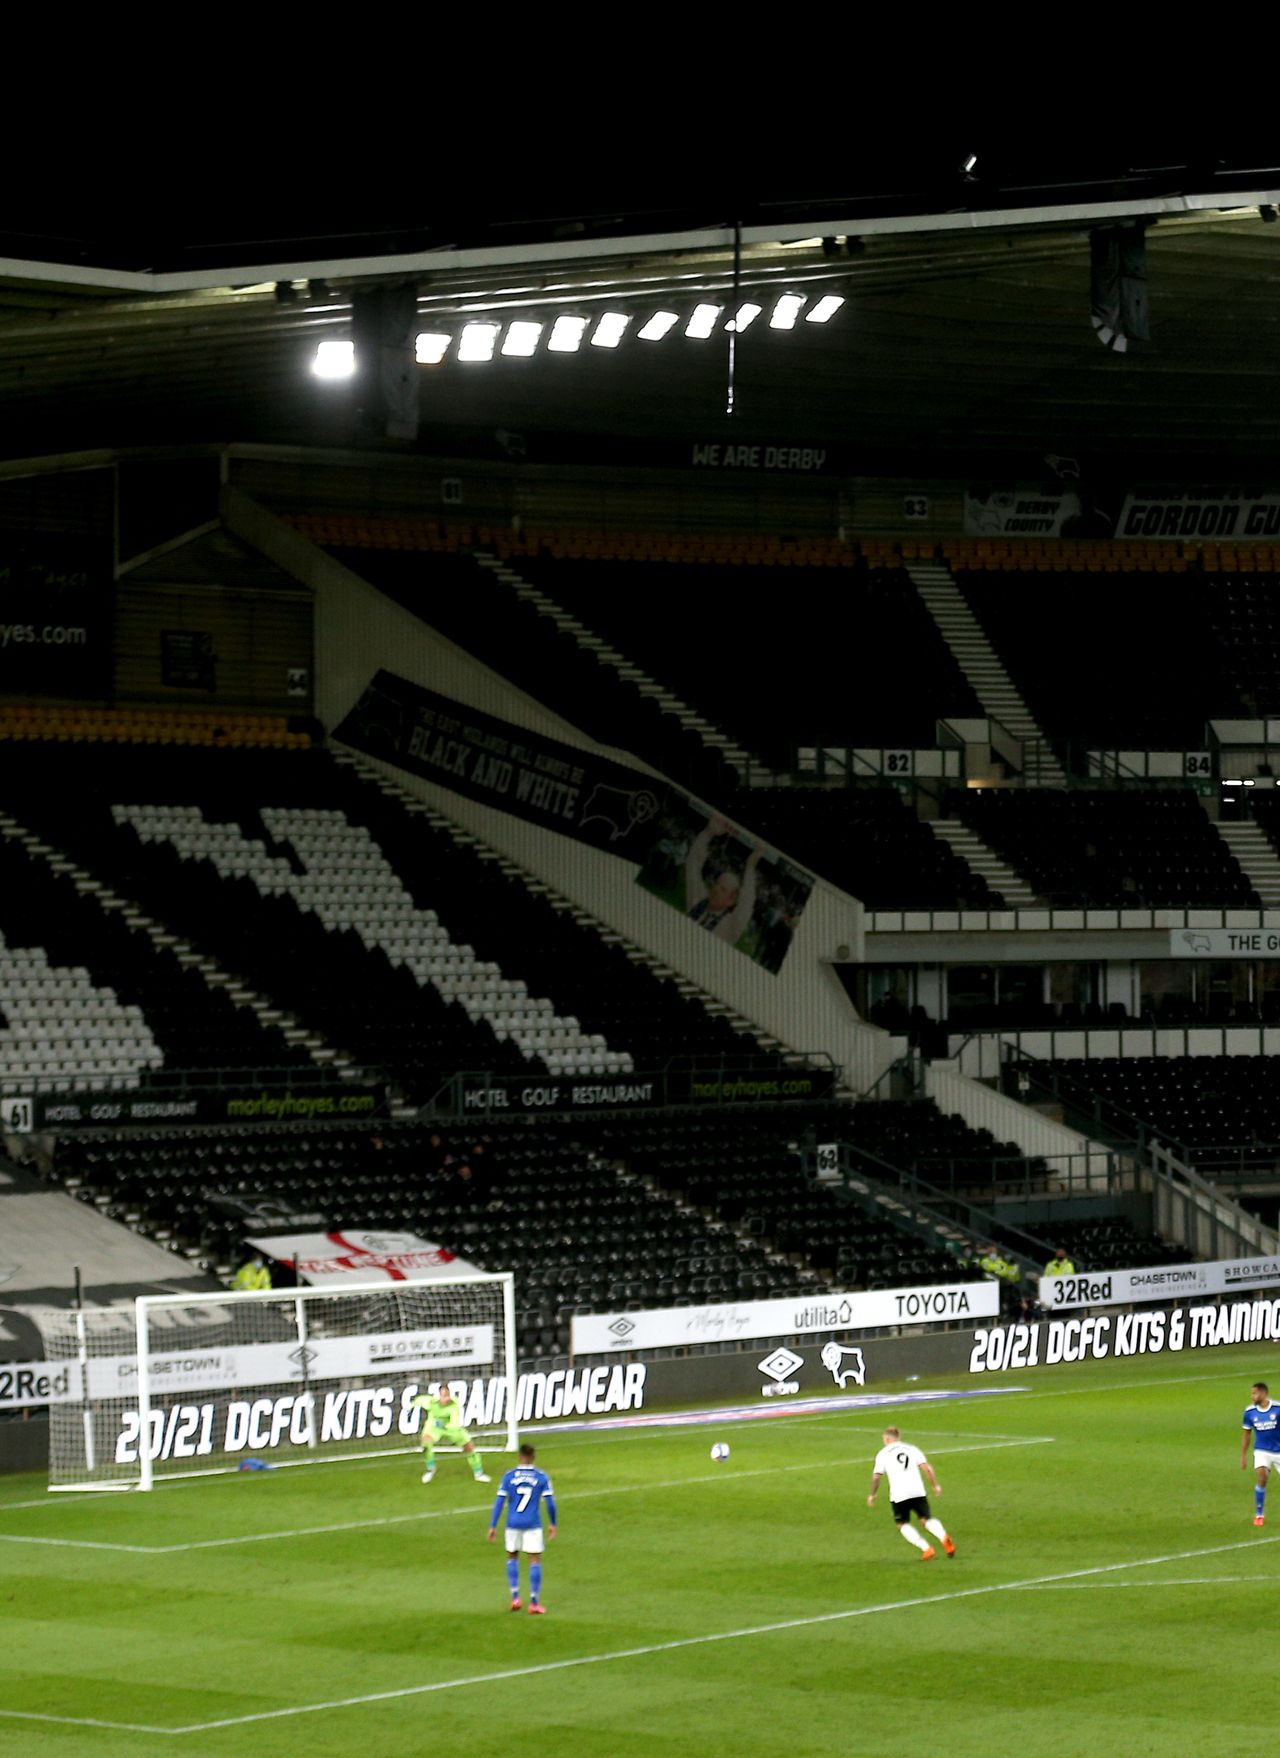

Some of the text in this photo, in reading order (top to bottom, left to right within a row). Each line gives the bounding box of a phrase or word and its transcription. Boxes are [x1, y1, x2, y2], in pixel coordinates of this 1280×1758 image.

[692, 443, 827, 470] WE ARE DERBY
[906, 499, 928, 517] 83
[1124, 504, 1240, 535] GORDON
[1005, 518, 1055, 532] COUNTY
[407, 725, 580, 820] BLACK AND WHITE
[887, 754, 909, 772] 82
[1187, 756, 1210, 774] 84
[1228, 935, 1262, 952] THE
[464, 1083, 655, 1109] HOTEL GOLF RESTAURANT
[10, 1103, 28, 1126] 61
[45, 1101, 198, 1121] HOTEL GOLF RESTAURANT
[1053, 1276, 1113, 1305] 32Red
[1130, 1271, 1197, 1287] CHASETOWN
[895, 1291, 970, 1318] TOYOTA
[794, 1306, 838, 1329] utilita
[368, 1336, 474, 1354] SHOWCASE
[969, 1323, 1041, 1373] 20/21
[1045, 1315, 1111, 1365] DCFC
[1114, 1309, 1167, 1357] KITS
[1168, 1308, 1184, 1351] &
[224, 1395, 315, 1453] DCFC
[321, 1386, 394, 1443] KITS
[896, 1452, 909, 1472] 9
[516, 1486, 533, 1513] 7
